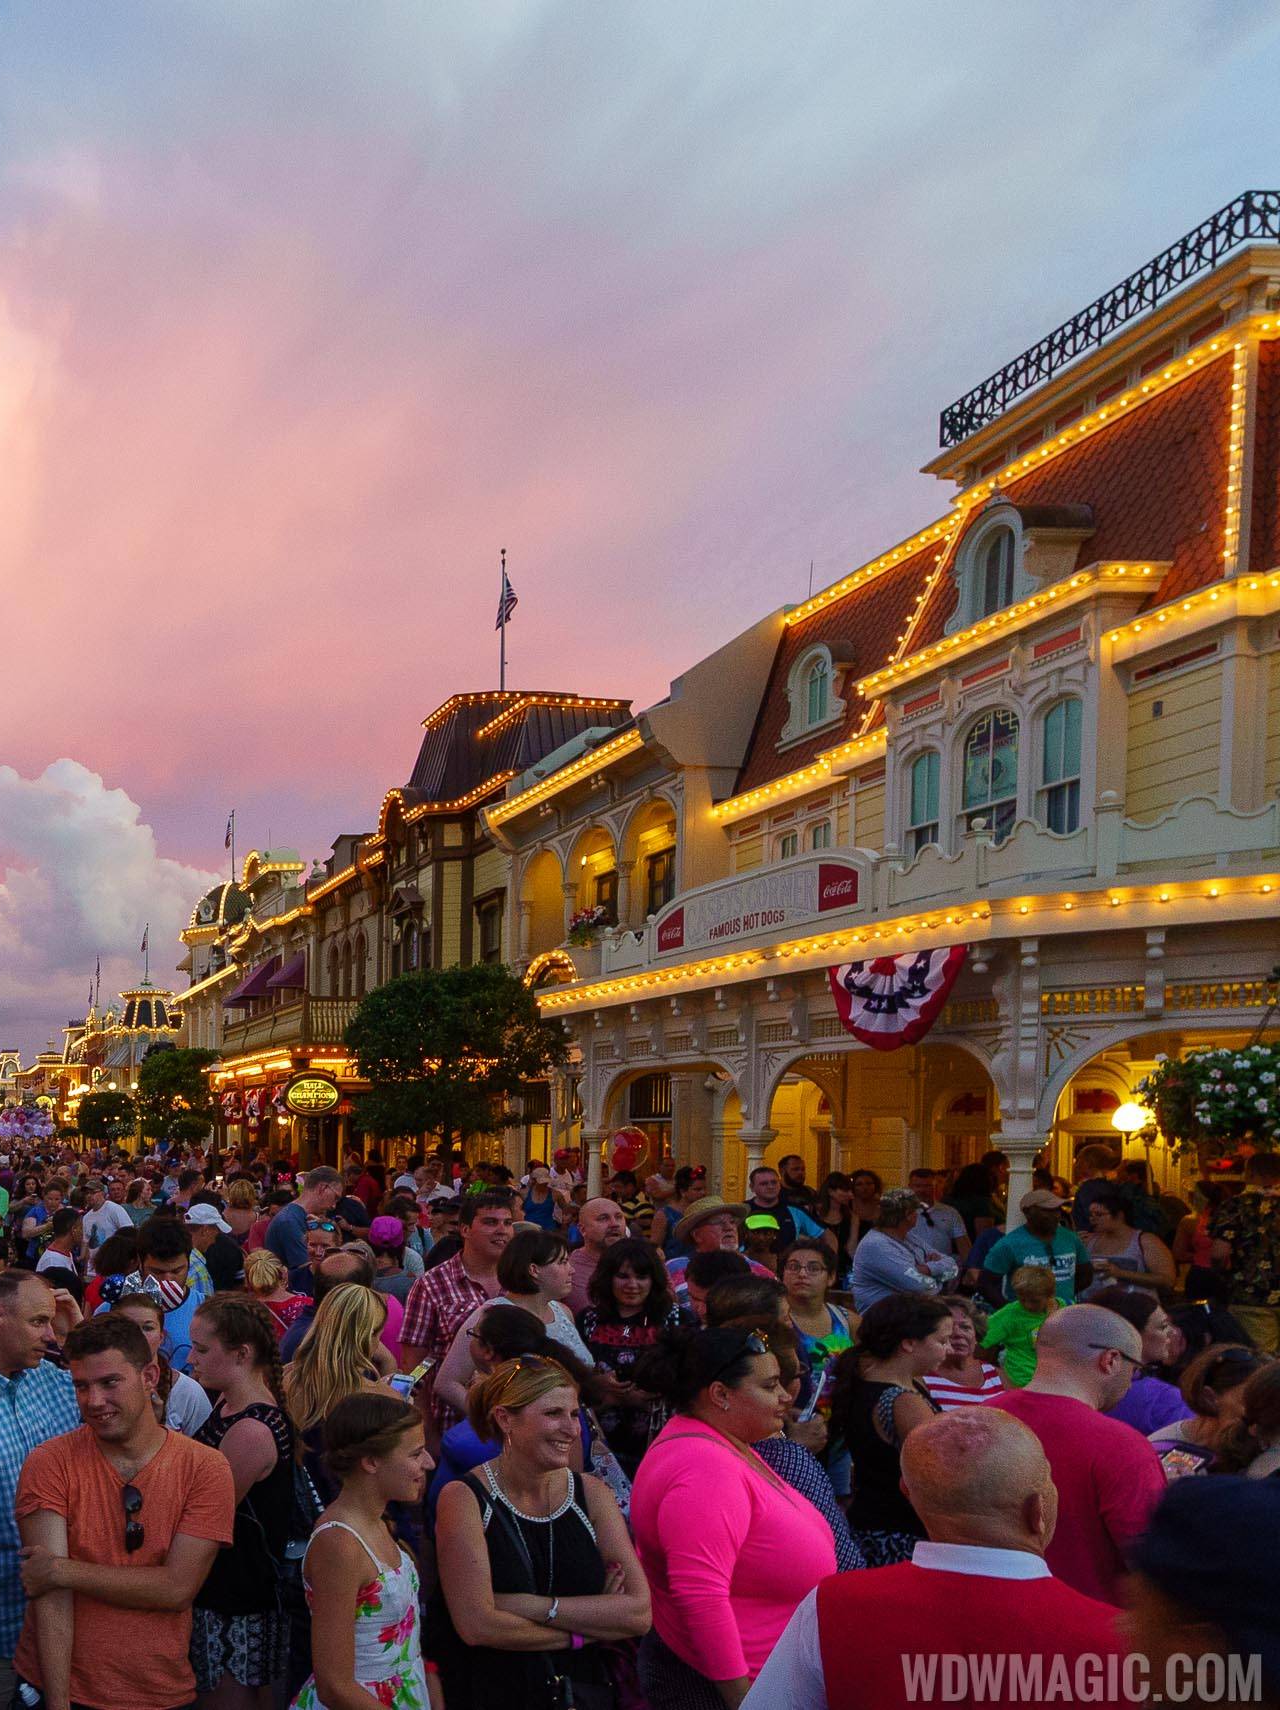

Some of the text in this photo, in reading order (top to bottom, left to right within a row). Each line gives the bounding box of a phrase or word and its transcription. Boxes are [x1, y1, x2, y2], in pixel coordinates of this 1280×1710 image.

[709, 918, 741, 941] FAMOUS
[742, 912, 761, 932] HOT
[761, 909, 785, 928] DOGS
